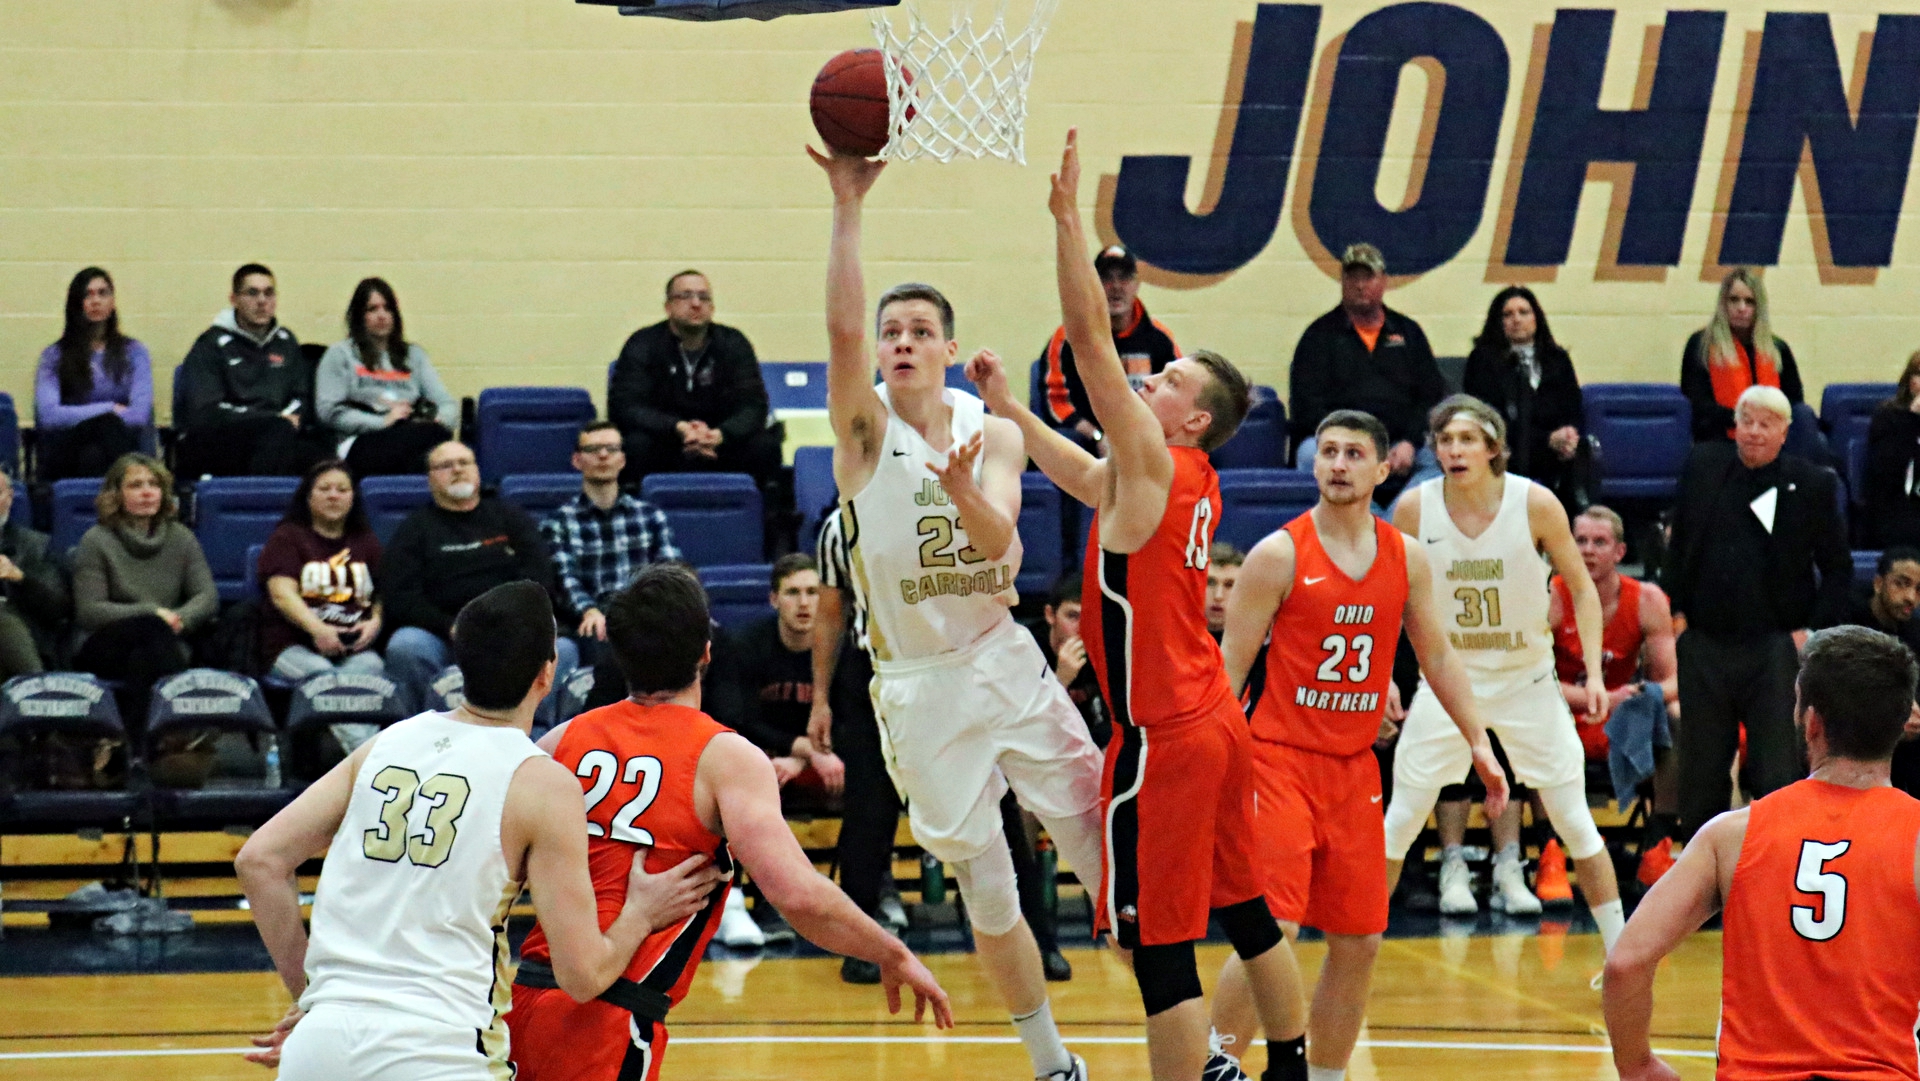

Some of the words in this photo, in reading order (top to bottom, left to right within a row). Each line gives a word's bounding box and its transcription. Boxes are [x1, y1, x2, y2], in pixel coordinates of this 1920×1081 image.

[1100, 1, 1920, 286] JOHN
[914, 478, 957, 506] JO
[1184, 496, 1212, 570] 13
[900, 564, 1010, 605] CARROLL
[1446, 559, 1504, 581] JOHN
[1334, 605, 1374, 624] OHIO
[1454, 587, 1502, 627] 31
[1316, 634, 1374, 682] 23
[1449, 631, 1528, 652] ARROLL
[1295, 686, 1379, 712] NORTHERN
[363, 765, 471, 868] 33
[576, 749, 663, 847] 22
[1790, 838, 1851, 942] 5
